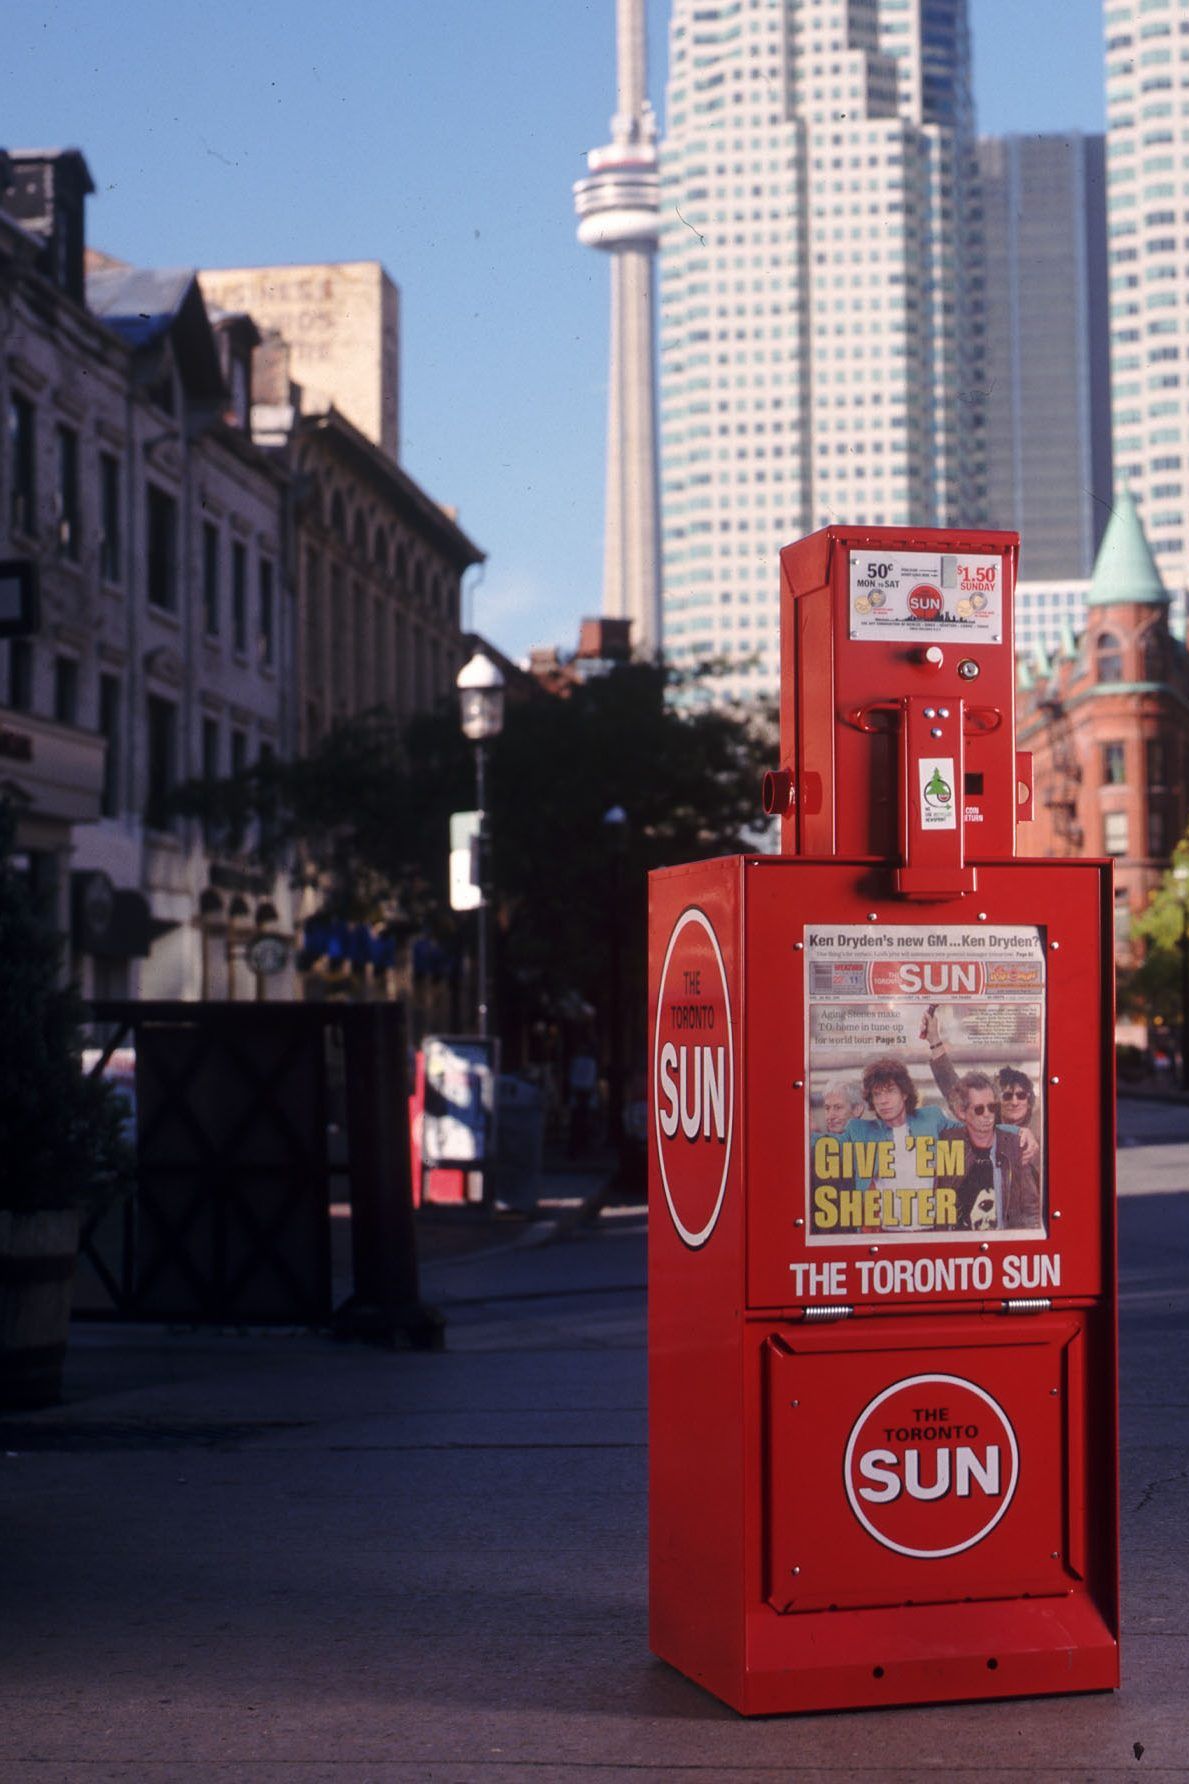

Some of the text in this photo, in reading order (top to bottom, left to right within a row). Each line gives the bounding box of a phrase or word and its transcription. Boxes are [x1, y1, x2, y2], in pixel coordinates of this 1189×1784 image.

[957, 565, 996, 582] $1.50
[857, 580, 875, 588] MON
[884, 580, 900, 589] SAT
[960, 582, 996, 592] SUNDAY
[910, 597, 940, 610] SUN
[964, 814, 984, 822] ETURN
[809, 934, 834, 947] Ken
[837, 934, 894, 949] Dryden's
[897, 936, 924, 947] new
[989, 935, 1040, 949] Dryden?
[683, 971, 701, 995] THE
[899, 963, 976, 993] SUN
[671, 1005, 714, 1030] TORONTO
[821, 1010, 846, 1020] Aging
[877, 1010, 900, 1018] make
[836, 1023, 860, 1031] home
[861, 1023, 869, 1031] in
[815, 1036, 826, 1044] for
[828, 1035, 852, 1044] world
[875, 1036, 895, 1045] Page
[659, 1041, 725, 1142] SUN
[814, 1136, 896, 1180] GIVE
[813, 1185, 958, 1229] SHELTER
[789, 1253, 1061, 1296] THE TORONTO SUN
[912, 1408, 949, 1422] THE
[884, 1425, 979, 1442] TORONTO
[858, 1445, 1000, 1503] SUN
